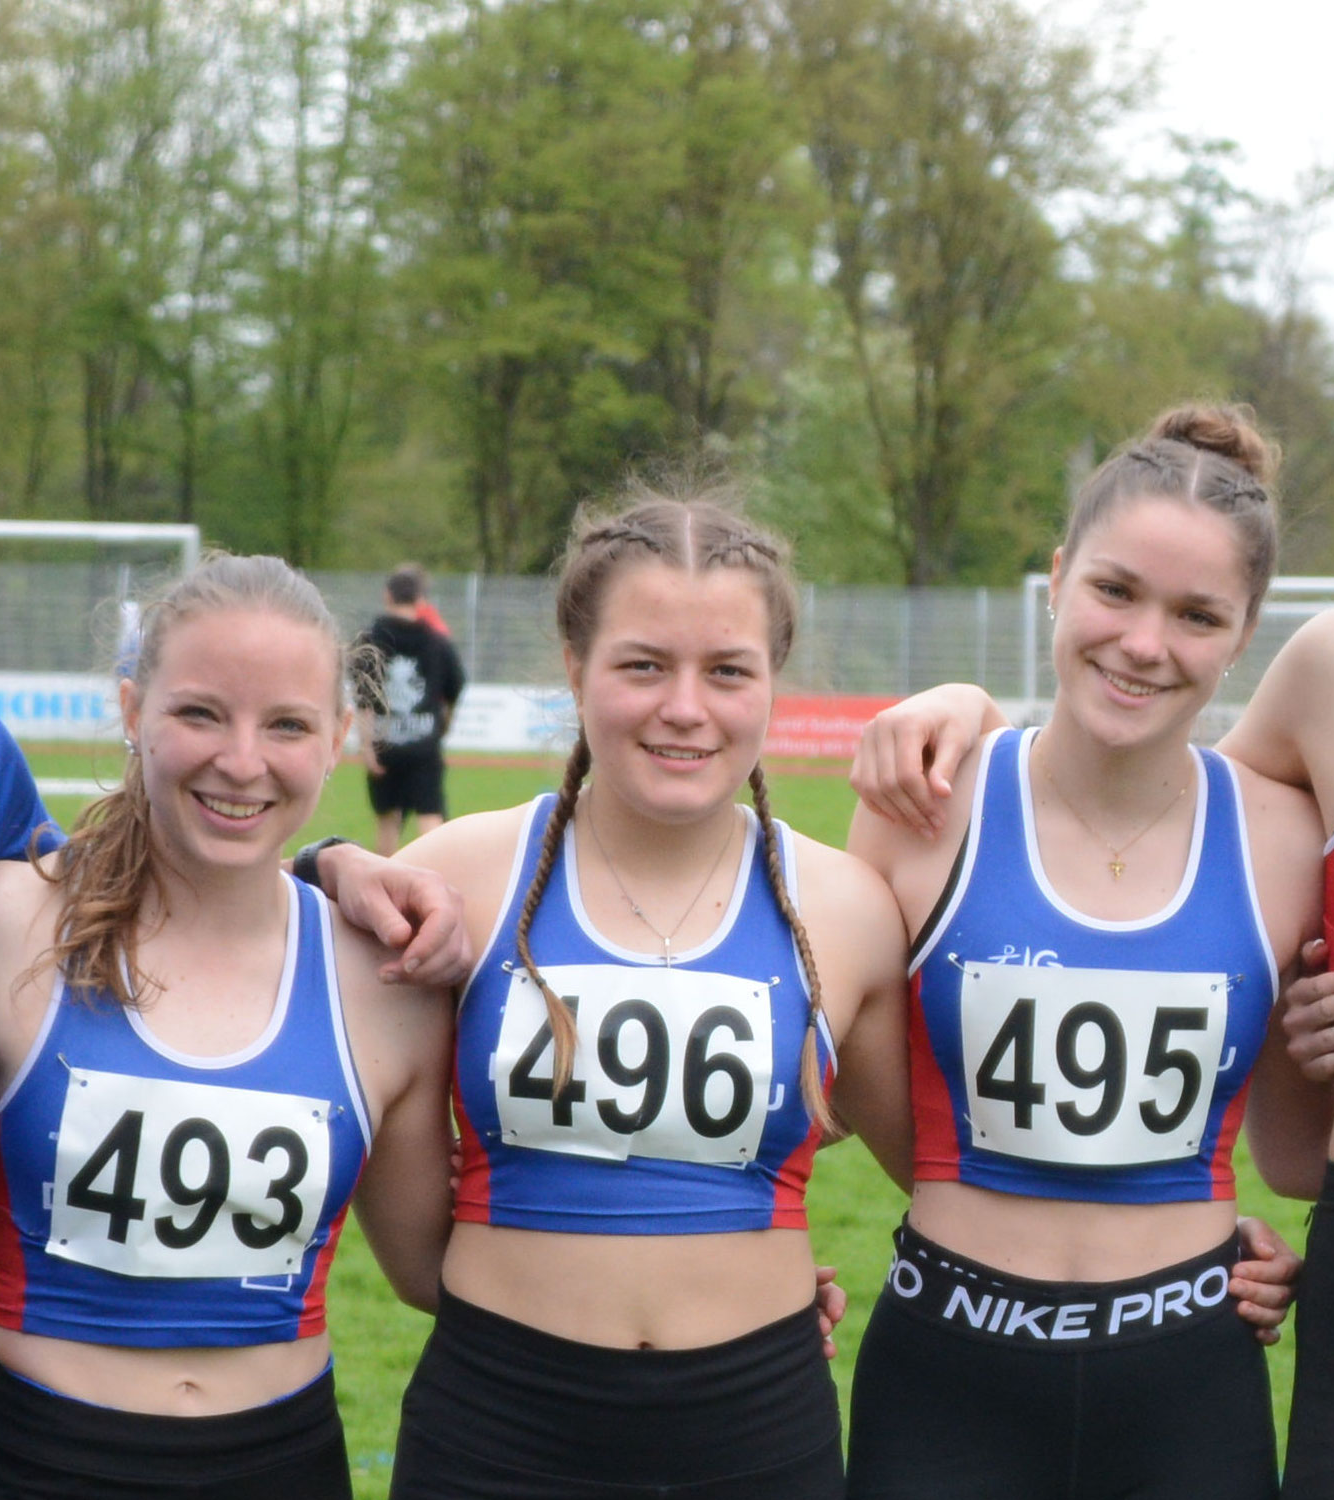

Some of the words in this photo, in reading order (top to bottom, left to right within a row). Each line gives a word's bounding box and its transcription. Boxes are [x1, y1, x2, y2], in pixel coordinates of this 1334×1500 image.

[509, 995, 754, 1138] 496
[976, 998, 1209, 1136] 495
[66, 1109, 309, 1250] 493
[942, 1285, 1097, 1340] NIKE
[1108, 1265, 1229, 1335] PRO
